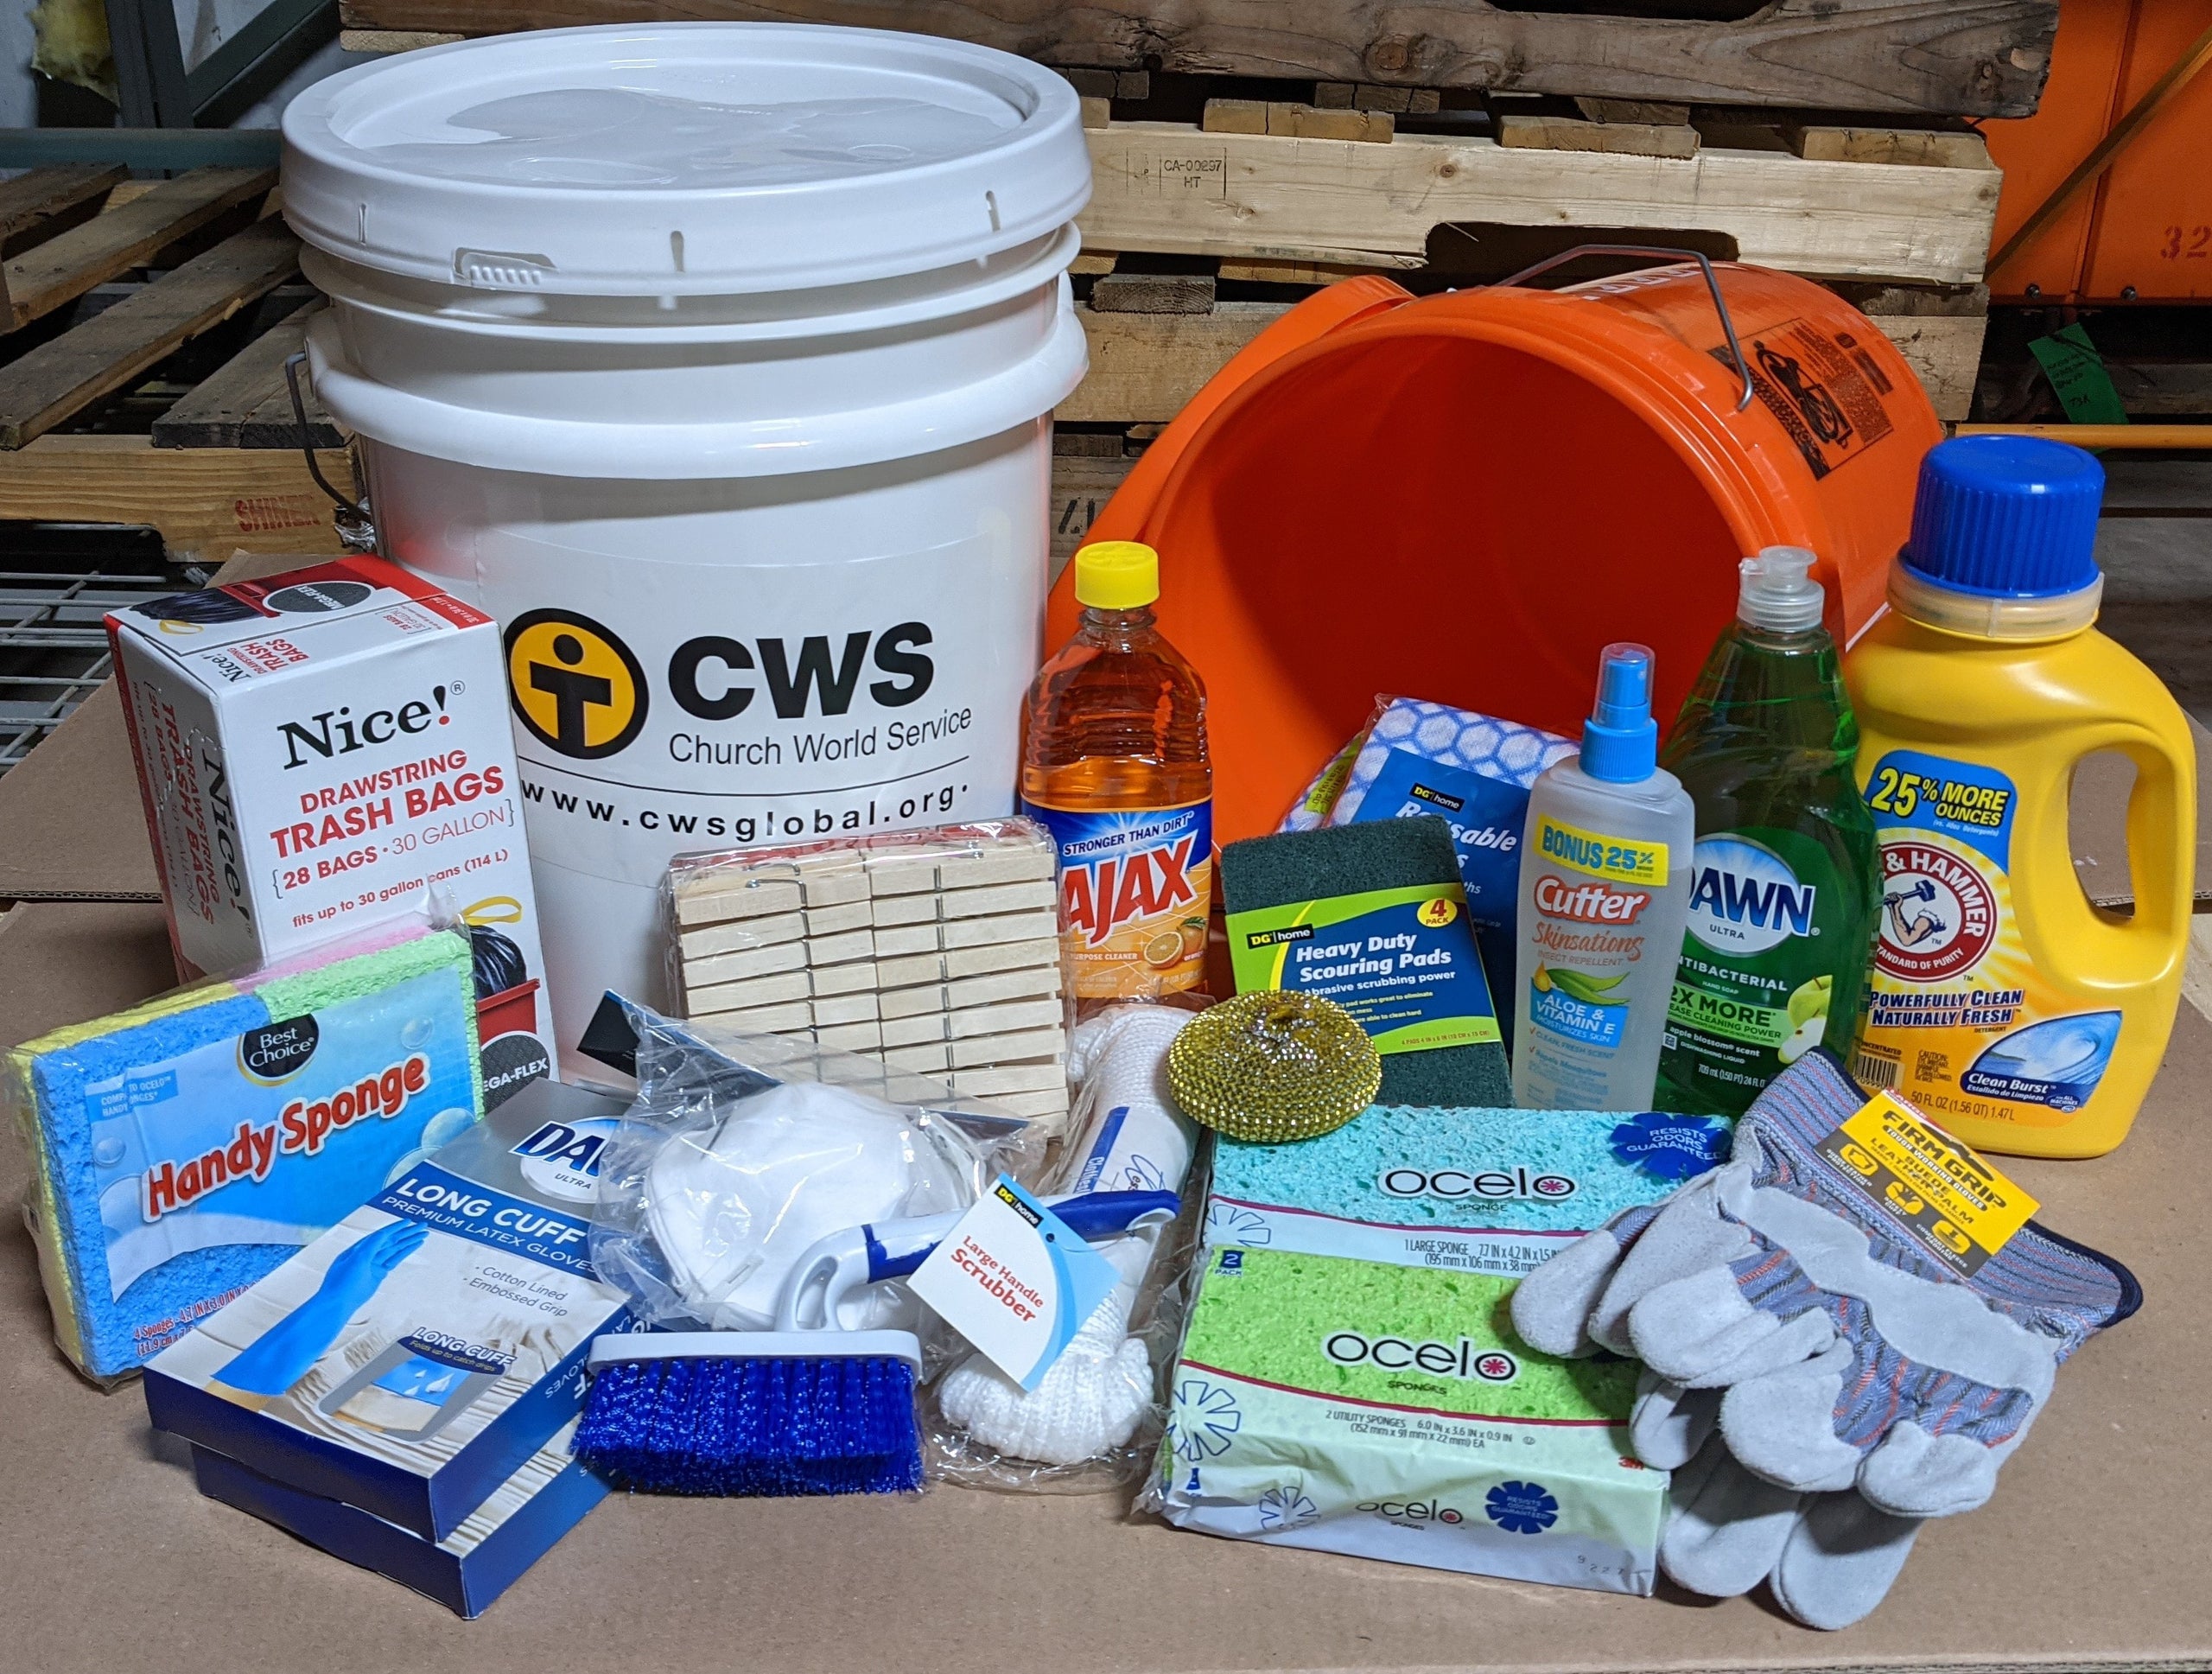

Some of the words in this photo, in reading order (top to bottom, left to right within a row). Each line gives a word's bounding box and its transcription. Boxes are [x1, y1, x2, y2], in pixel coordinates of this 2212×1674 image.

[1185, 176, 1201, 188] HT
[241, 642, 289, 671] TRASH
[266, 639, 309, 662] BAGS
[669, 621, 934, 721] CWS
[670, 734, 782, 765] Church
[794, 728, 877, 763] World
[887, 706, 972, 751] Service
[301, 750, 467, 814] DRAWSTRING
[1941, 782, 2008, 811] MORE
[162, 702, 194, 820] TRASH
[186, 826, 215, 925] BAGS
[270, 797, 394, 858] TRASH
[407, 767, 504, 819] BAGS
[1434, 793, 1460, 810] home
[1936, 803, 2001, 826] OUNCES
[1065, 834, 1126, 855] STRONGER
[1129, 826, 1160, 843] THAN
[1542, 825, 1603, 869] BONUS
[317, 846, 378, 879] BAGS
[392, 833, 416, 855] 30
[293, 913, 314, 927] fits
[318, 907, 336, 921] up
[340, 901, 354, 911] to
[359, 893, 375, 906] 30
[380, 877, 423, 900] gallon
[429, 866, 461, 882] cans
[1065, 837, 1193, 945] AJAX
[1536, 879, 1645, 919] Cutter
[1690, 866, 1815, 934] AWN
[1910, 851, 1987, 938] HAMMER
[1426, 916, 1449, 925] PACK
[1429, 899, 1446, 917] 4
[1278, 928, 1311, 942] home
[1532, 921, 1644, 961] Skinsations
[1710, 924, 1745, 939] ULTRA
[1297, 941, 1363, 963] Heavy
[1368, 933, 1417, 953] Duty
[1569, 954, 1624, 965] REPELLENT
[1920, 961, 1932, 970] OF
[1934, 948, 1964, 968] PURITY
[1300, 958, 1393, 982] Scouring
[1399, 949, 1452, 969] Pads
[1357, 974, 1415, 990] scrubbing
[1419, 971, 1457, 985] power
[1544, 995, 1587, 1016] ALOE
[1870, 992, 1967, 1009] POWERFULLY
[1970, 990, 2022, 1005] CLEAN
[1536, 1002, 1599, 1032] VITAMIN
[1604, 1023, 1616, 1034] E
[1694, 1012, 1741, 1031] CLEANING
[1745, 1026, 1781, 1038] POWER
[1872, 1009, 1957, 1026] NATURALLY
[1960, 1009, 2012, 1023] FRESH
[260, 1028, 297, 1048] Best
[1670, 1026, 1693, 1038] apple
[1736, 1047, 1761, 1057] scent
[250, 1040, 311, 1067] Choice
[1969, 1073, 2007, 1089] Clean
[2009, 1080, 2049, 1094] Burst
[1911, 1091, 1924, 1103] 50
[1936, 1096, 1948, 1110] OZ
[148, 1124, 276, 1217] Handy
[281, 1058, 427, 1149] Sponge
[1649, 1128, 1707, 1143] RESISTS
[1652, 1135, 1703, 1150] ODORS
[1883, 1110, 1945, 1161] FIRM
[1944, 1158, 2007, 1208] GRIP
[1913, 1150, 1953, 1183] WORKING
[554, 1173, 593, 1190] ULTRA
[1385, 1168, 1575, 1197] ocelo
[382, 1195, 465, 1228] PREMIUM
[465, 1221, 525, 1247] LATEX
[396, 1178, 493, 1217] LONG
[494, 1208, 588, 1245] CUFF
[1455, 1203, 1508, 1212] SPONGE
[1224, 1254, 1238, 1264] 2
[1409, 1239, 1436, 1252] LARGE
[1437, 1241, 1469, 1255] SPONGE
[482, 1266, 527, 1288] Cotton
[529, 1281, 569, 1301] Lined
[950, 1248, 1037, 1323] Scrubber
[963, 1235, 998, 1270] Large
[999, 1265, 1044, 1308] Handle
[468, 1277, 537, 1308] Embossed
[539, 1301, 569, 1317] Grip
[143, 1318, 174, 1337] Sponges
[412, 1327, 464, 1352] LONG
[466, 1346, 517, 1366] CUFF
[1327, 1334, 1516, 1381] ocelo
[1387, 1380, 1447, 1395] SPONGES
[1333, 1411, 1364, 1423] UTILITY
[1366, 1414, 1406, 1429] SPONGES
[1355, 1499, 1463, 1524] ocelo
